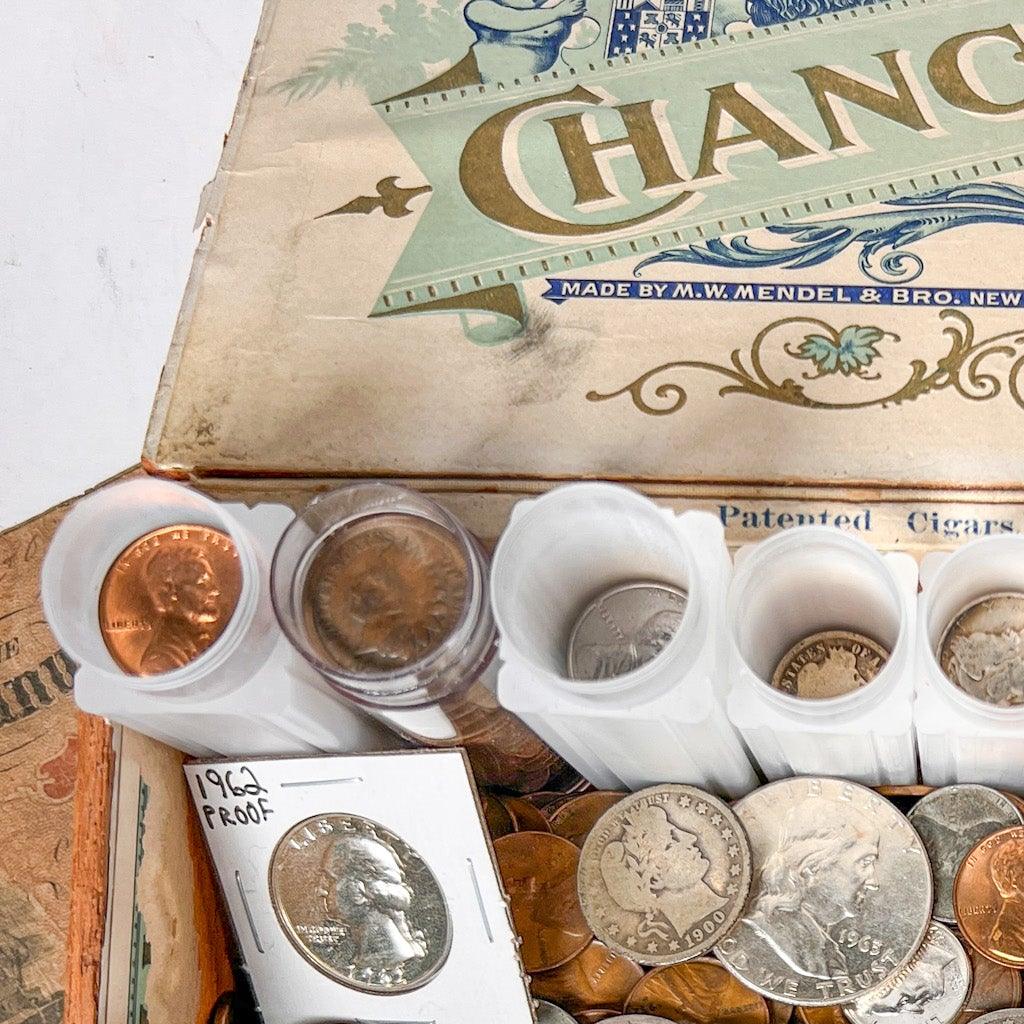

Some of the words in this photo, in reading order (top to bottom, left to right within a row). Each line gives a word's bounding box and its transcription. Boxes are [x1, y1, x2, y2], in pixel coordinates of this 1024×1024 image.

[560, 281, 631, 299] MADE
[638, 283, 670, 300] BY
[672, 284, 729, 300] M.W.
[733, 285, 853, 304] MENDEL
[858, 287, 882, 304] &
[891, 288, 962, 306] BRO.
[968, 290, 1022, 308] NEW
[718, 504, 872, 531] Patented
[196, 766, 268, 799] 1962
[202, 798, 275, 830] PROOF
[684, 909, 727, 949] 1900
[758, 964, 800, 998] WE
[815, 949, 900, 1000] TRUST
